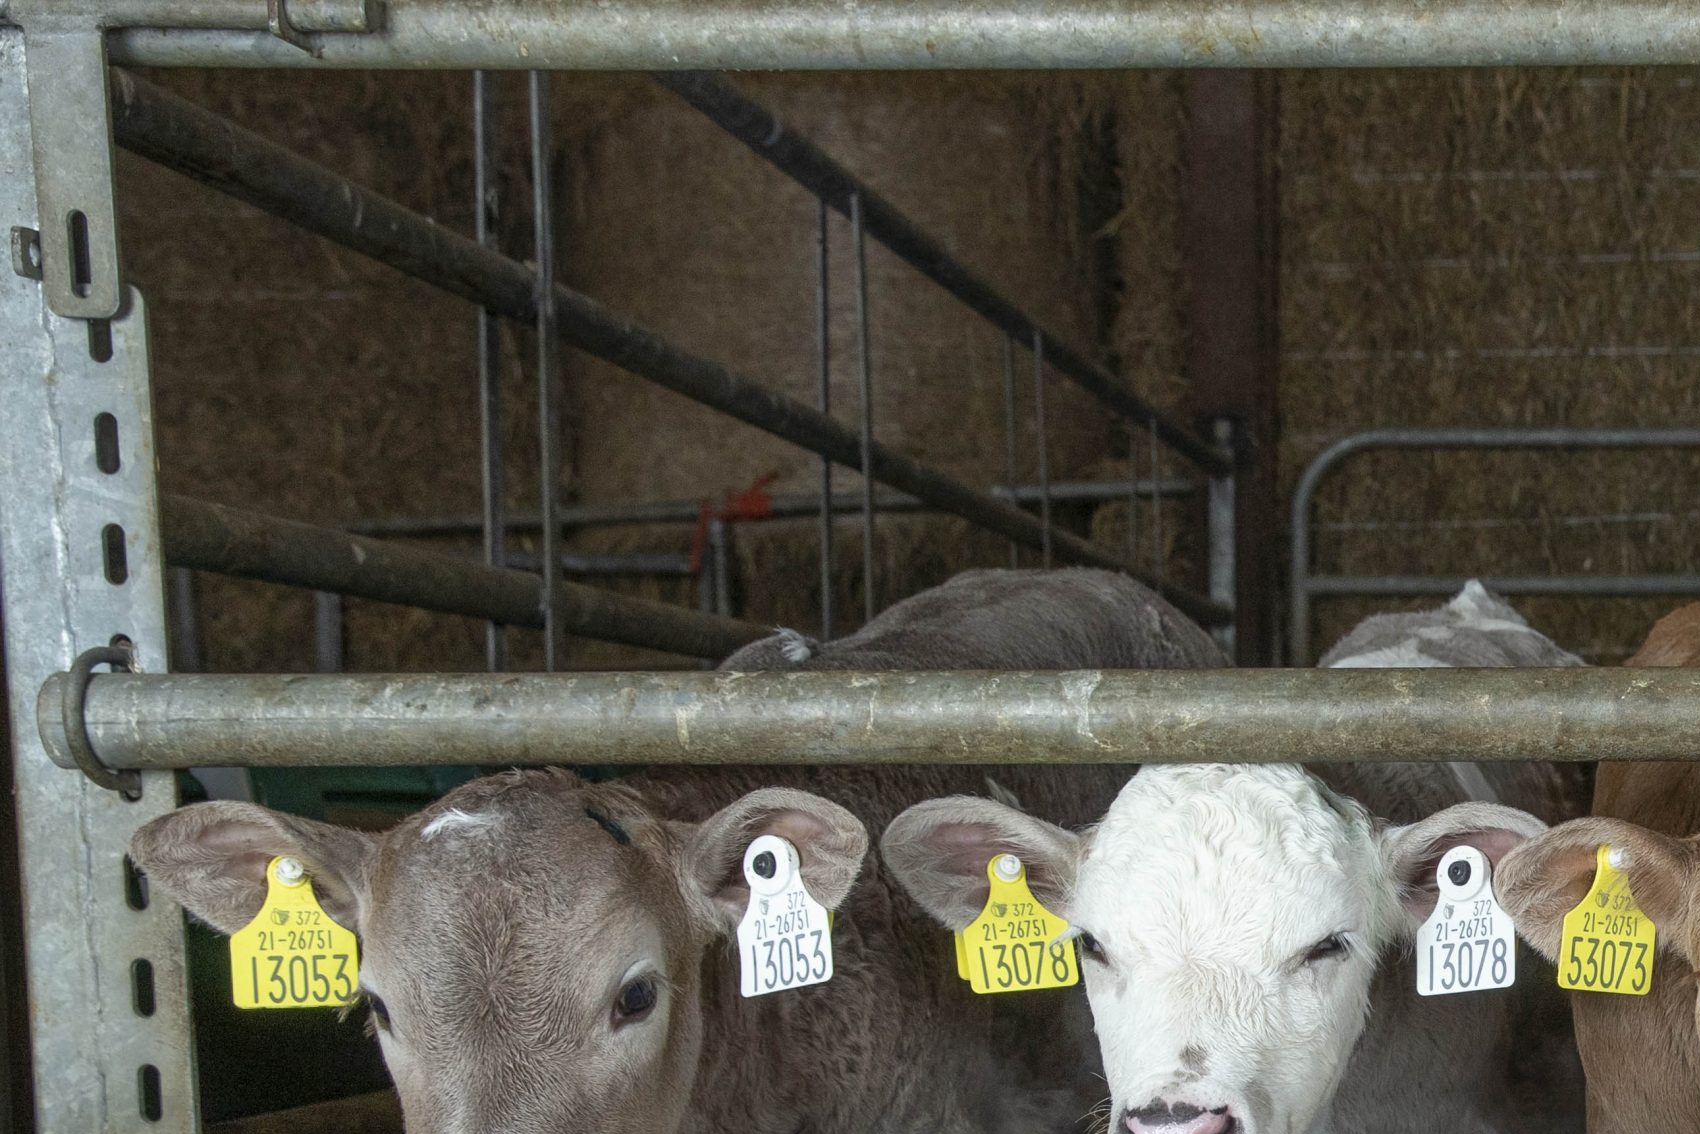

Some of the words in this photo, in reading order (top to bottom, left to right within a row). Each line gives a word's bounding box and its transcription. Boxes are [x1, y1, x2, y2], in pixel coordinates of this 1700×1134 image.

[787, 891, 806, 910] 372
[1013, 903, 1034, 916] 372
[1473, 900, 1492, 916] 372
[1612, 895, 1632, 912] 372
[296, 911, 320, 925] 372
[755, 909, 810, 940] 21-26751
[982, 919, 1047, 941] 21-26751
[1436, 917, 1493, 942] 21-26751
[1583, 912, 1638, 937] 21-26751
[258, 930, 332, 950] 21-26751
[752, 930, 826, 992] 13053
[980, 941, 1069, 989] 13078
[1430, 938, 1507, 991] 13078
[1567, 936, 1648, 991] 53073
[252, 954, 352, 1004] 13053
